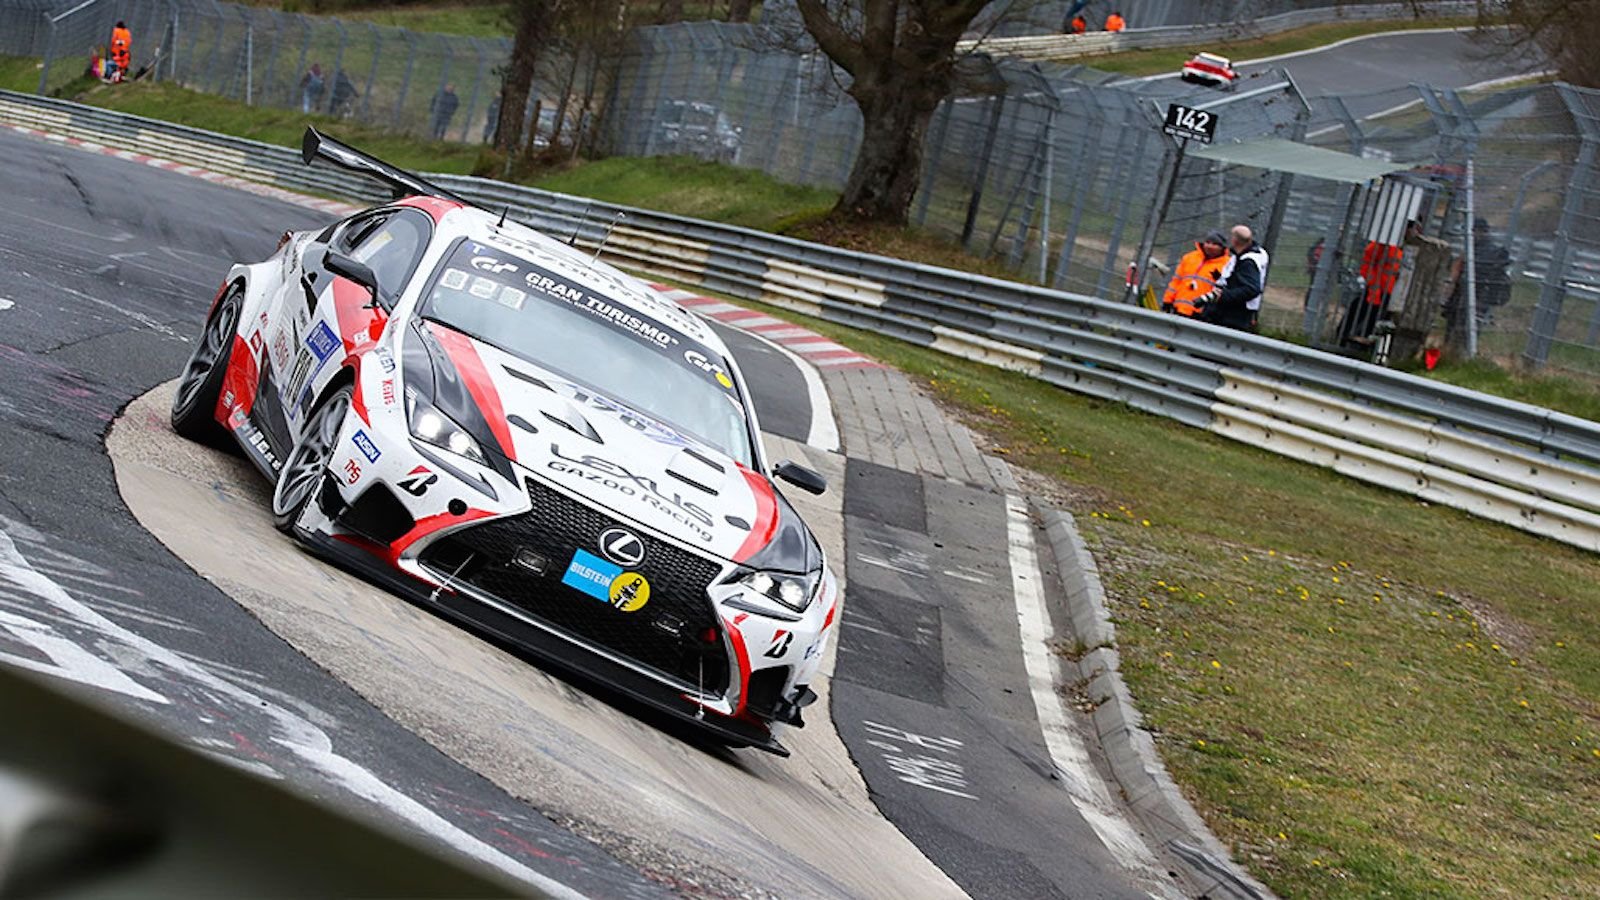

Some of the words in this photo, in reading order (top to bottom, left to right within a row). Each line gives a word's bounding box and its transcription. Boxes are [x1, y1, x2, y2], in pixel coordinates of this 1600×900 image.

[1176, 107, 1209, 133] 142
[525, 272, 583, 301] GRAN
[586, 296, 675, 345] TURISMO
[547, 461, 636, 496] GAZOO
[641, 494, 714, 542] Racing
[550, 443, 714, 527] LEXUS
[570, 562, 611, 587] BILSTEIN
